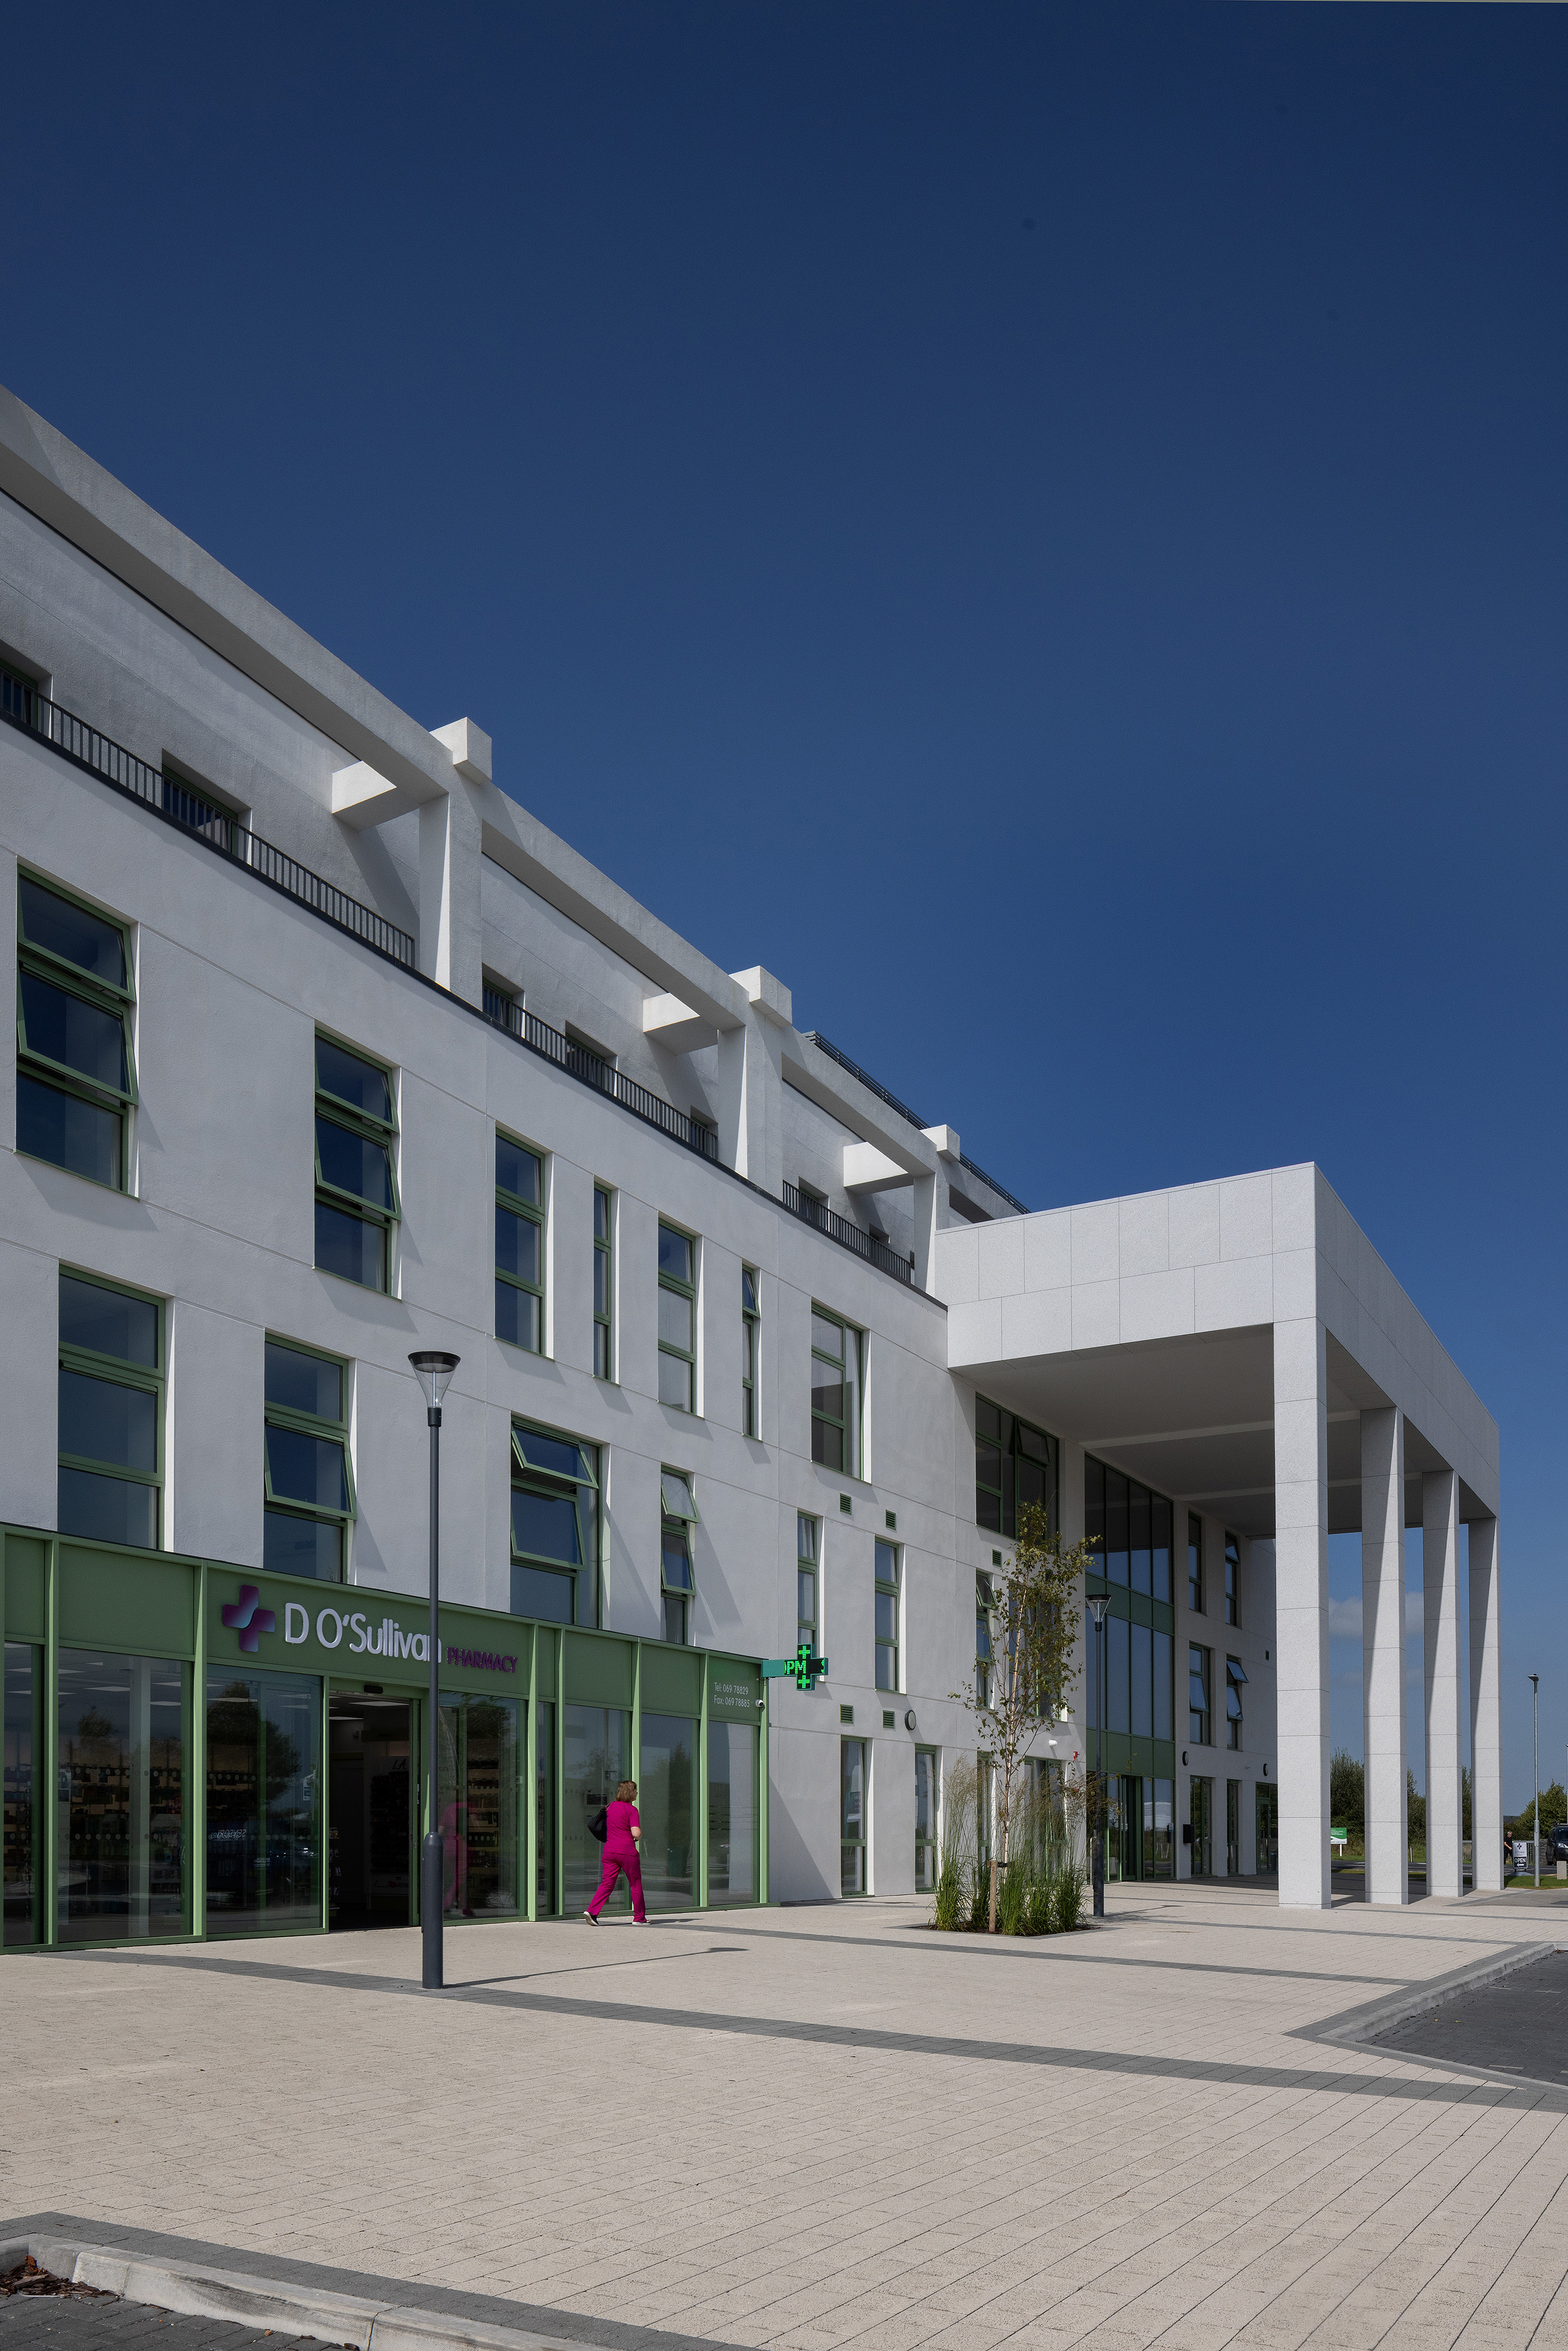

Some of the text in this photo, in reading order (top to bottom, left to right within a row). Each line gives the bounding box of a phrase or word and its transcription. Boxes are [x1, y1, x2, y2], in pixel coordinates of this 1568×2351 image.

[285, 1603, 309, 1644] D
[447, 1647, 518, 1673] PHARMACY
[714, 1682, 748, 1695] Tel: 069 78829
[714, 1695, 750, 1708] Fax: 069 78885
[393, 1759, 407, 1770] L.A.
